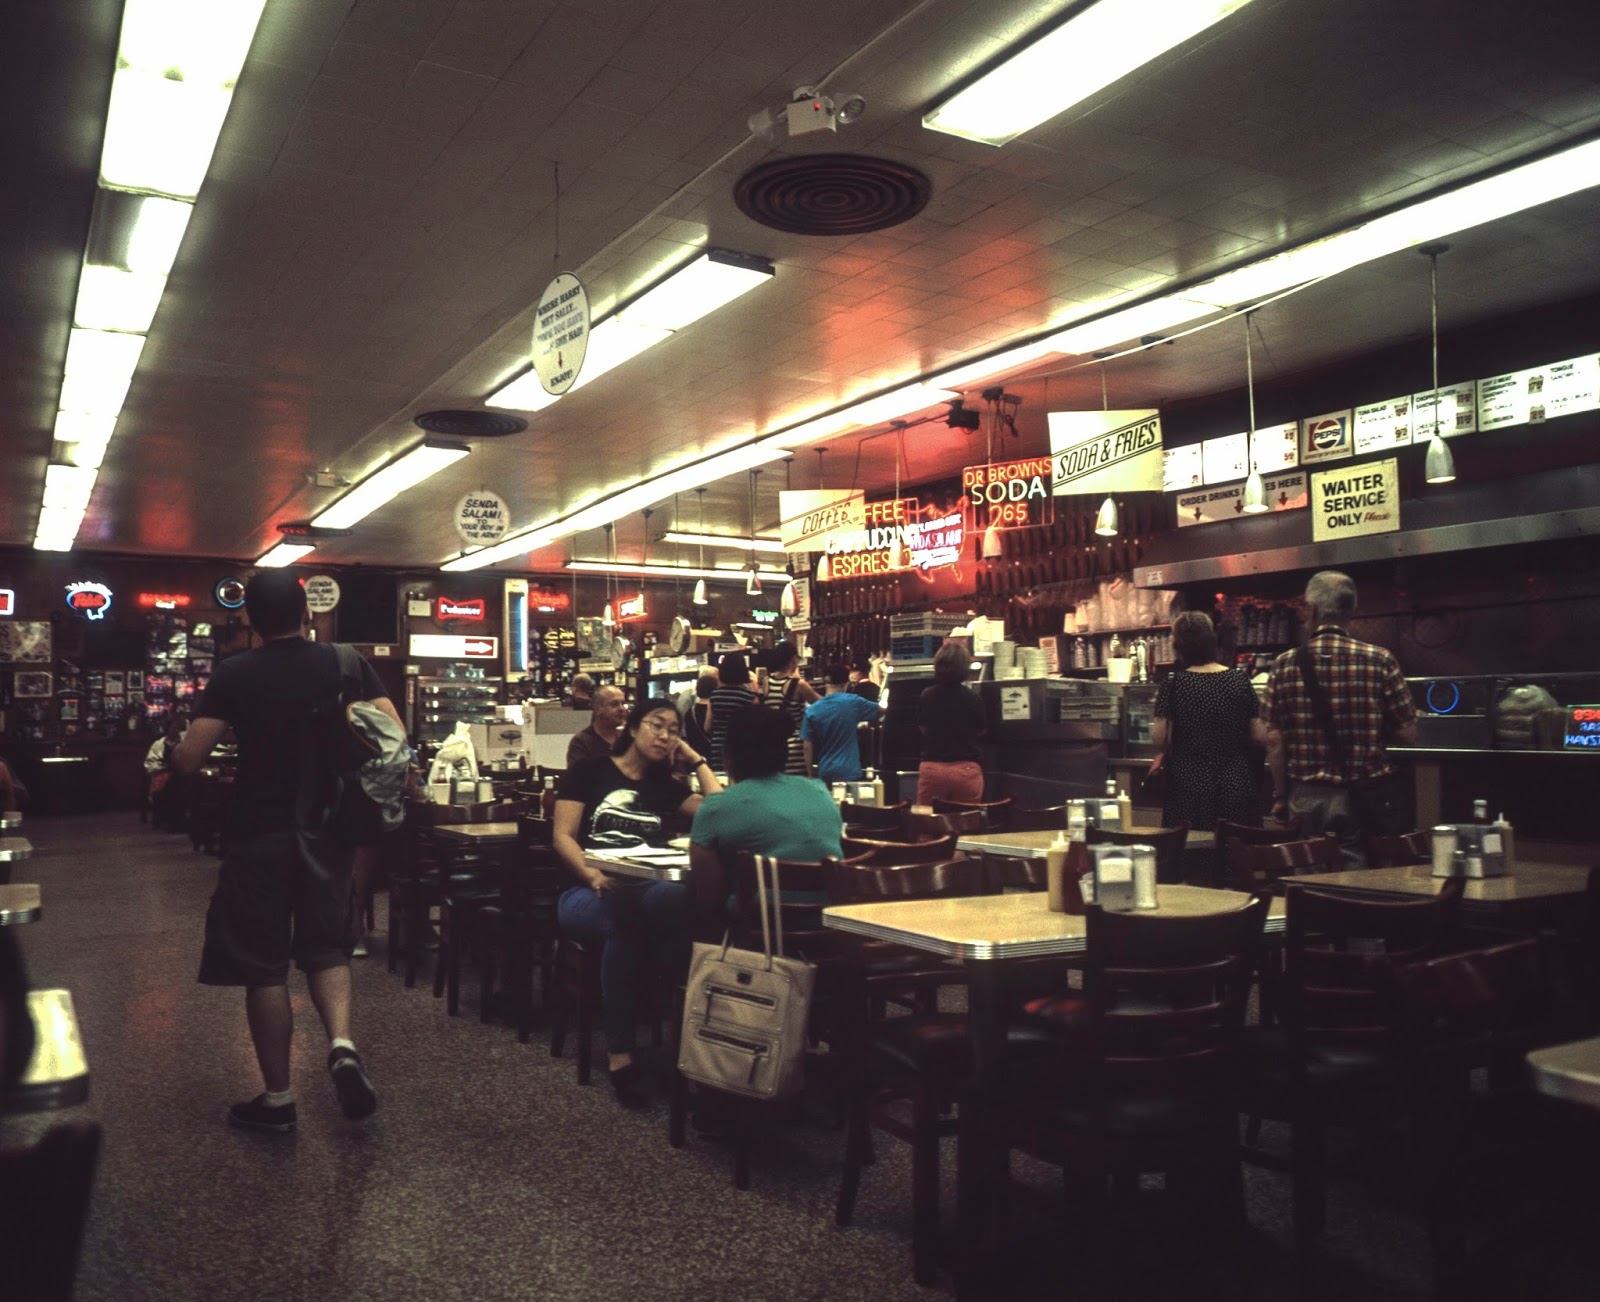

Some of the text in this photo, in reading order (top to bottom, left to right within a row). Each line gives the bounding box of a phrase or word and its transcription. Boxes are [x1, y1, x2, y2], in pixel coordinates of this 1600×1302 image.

[1314, 428, 1341, 440] PEPSI
[1057, 421, 1157, 479] SODA & FRIES
[964, 458, 1052, 486] DR BROWNS
[1278, 476, 1303, 488] HERE
[971, 475, 1047, 505] SODA
[1322, 473, 1384, 497] WAITER
[1181, 495, 1207, 506] ORDER
[1208, 488, 1239, 502] DRINKS
[1324, 490, 1385, 513] SERVICE
[461, 508, 502, 519] SALAMI
[989, 503, 1028, 529] 265
[1327, 512, 1362, 528] ONLY
